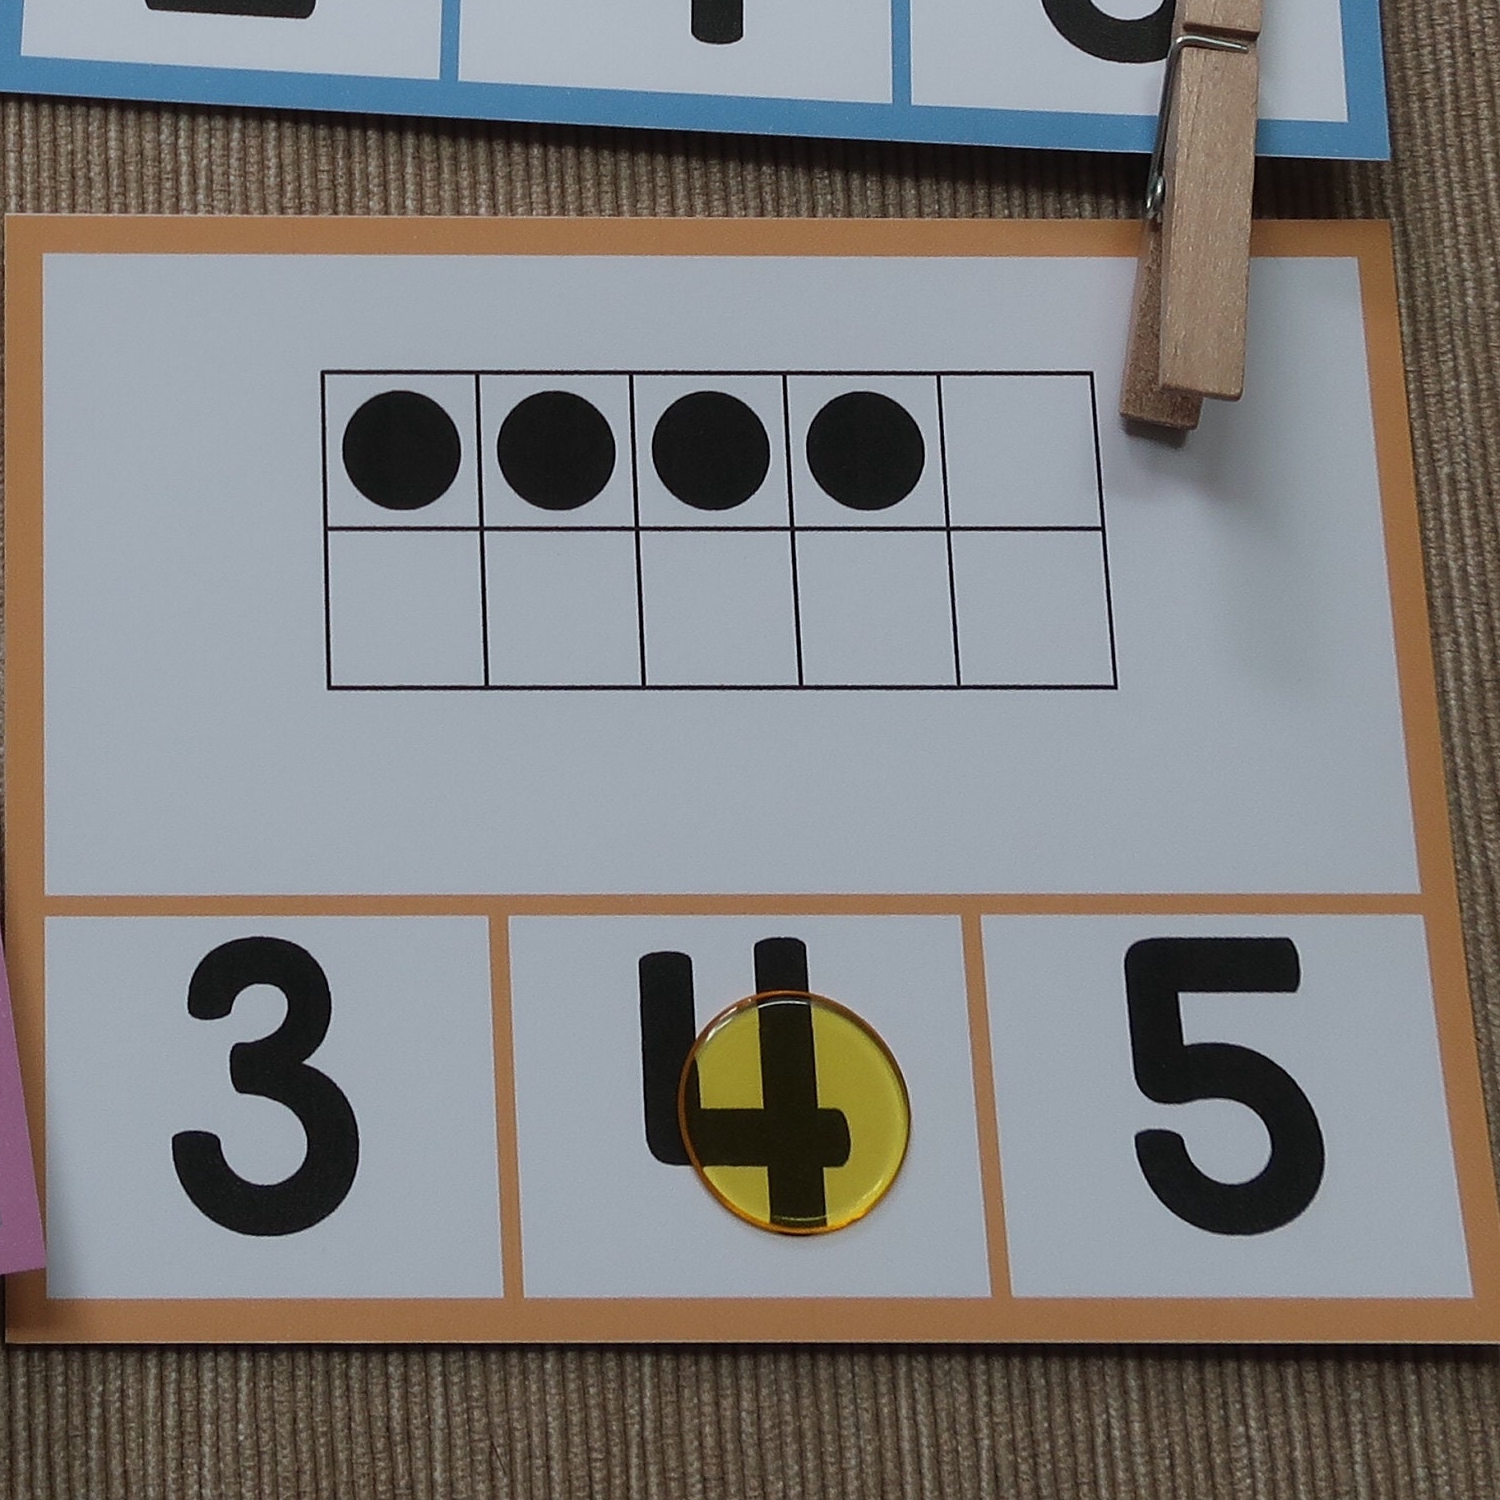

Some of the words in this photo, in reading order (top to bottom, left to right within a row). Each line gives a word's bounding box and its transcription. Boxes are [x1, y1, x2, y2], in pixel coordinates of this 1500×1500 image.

[171, 936, 360, 1237] 3
[638, 936, 851, 1231] 4
[1124, 937, 1325, 1236] 5
